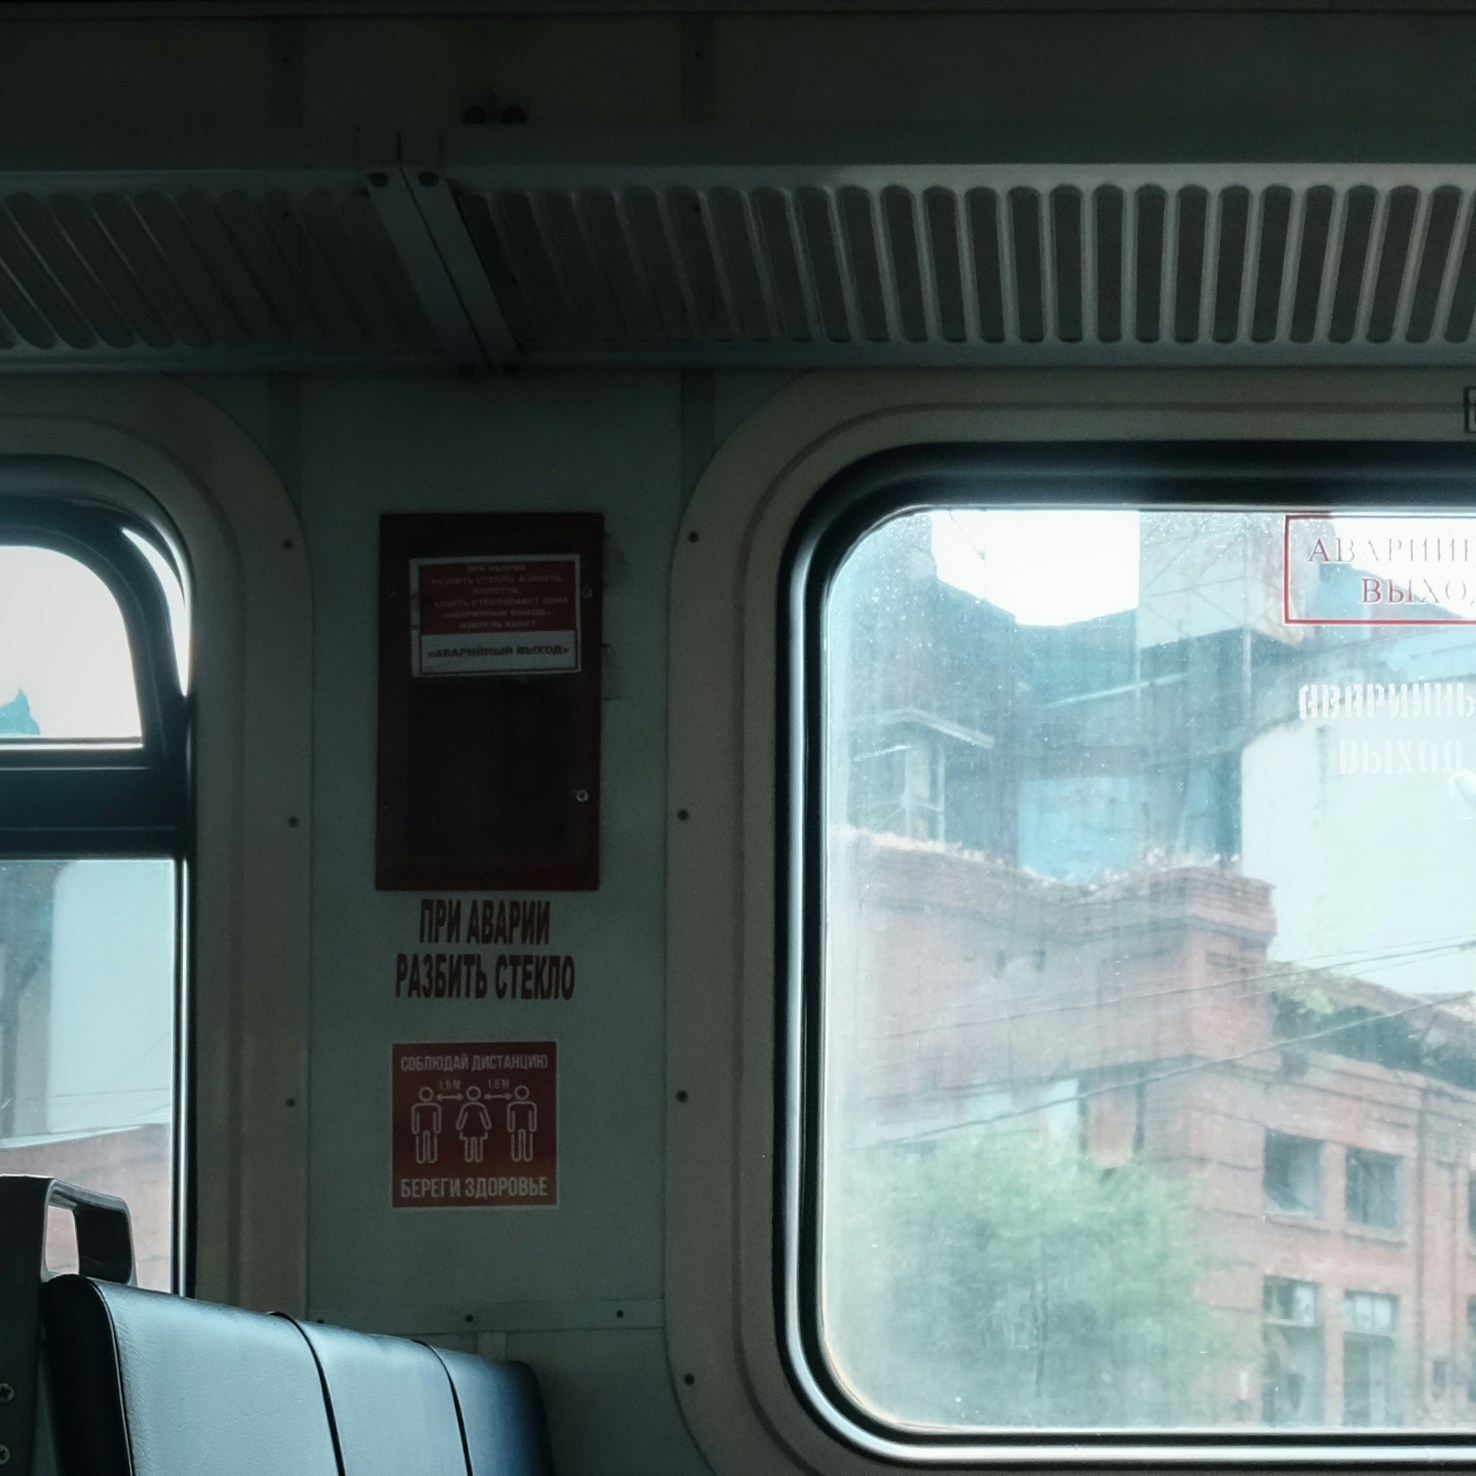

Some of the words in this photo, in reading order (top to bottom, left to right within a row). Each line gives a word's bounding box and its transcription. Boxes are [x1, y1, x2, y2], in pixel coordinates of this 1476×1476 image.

[1338, 738, 1463, 775] ВЫХОД
[420, 899, 461, 943] ПРИ
[467, 899, 550, 945] АВАРИИ
[395, 954, 488, 999] РАЗБИТЬ
[495, 955, 575, 1000] СТЕКЛО
[400, 1053, 469, 1072] СОБЛЮДАЙ
[471, 1053, 548, 1072] ДИСТАНЦИЮ
[401, 1177, 461, 1198] БЕРЕГИ
[464, 1176, 548, 1199] ЗДОРОВЬЕ
